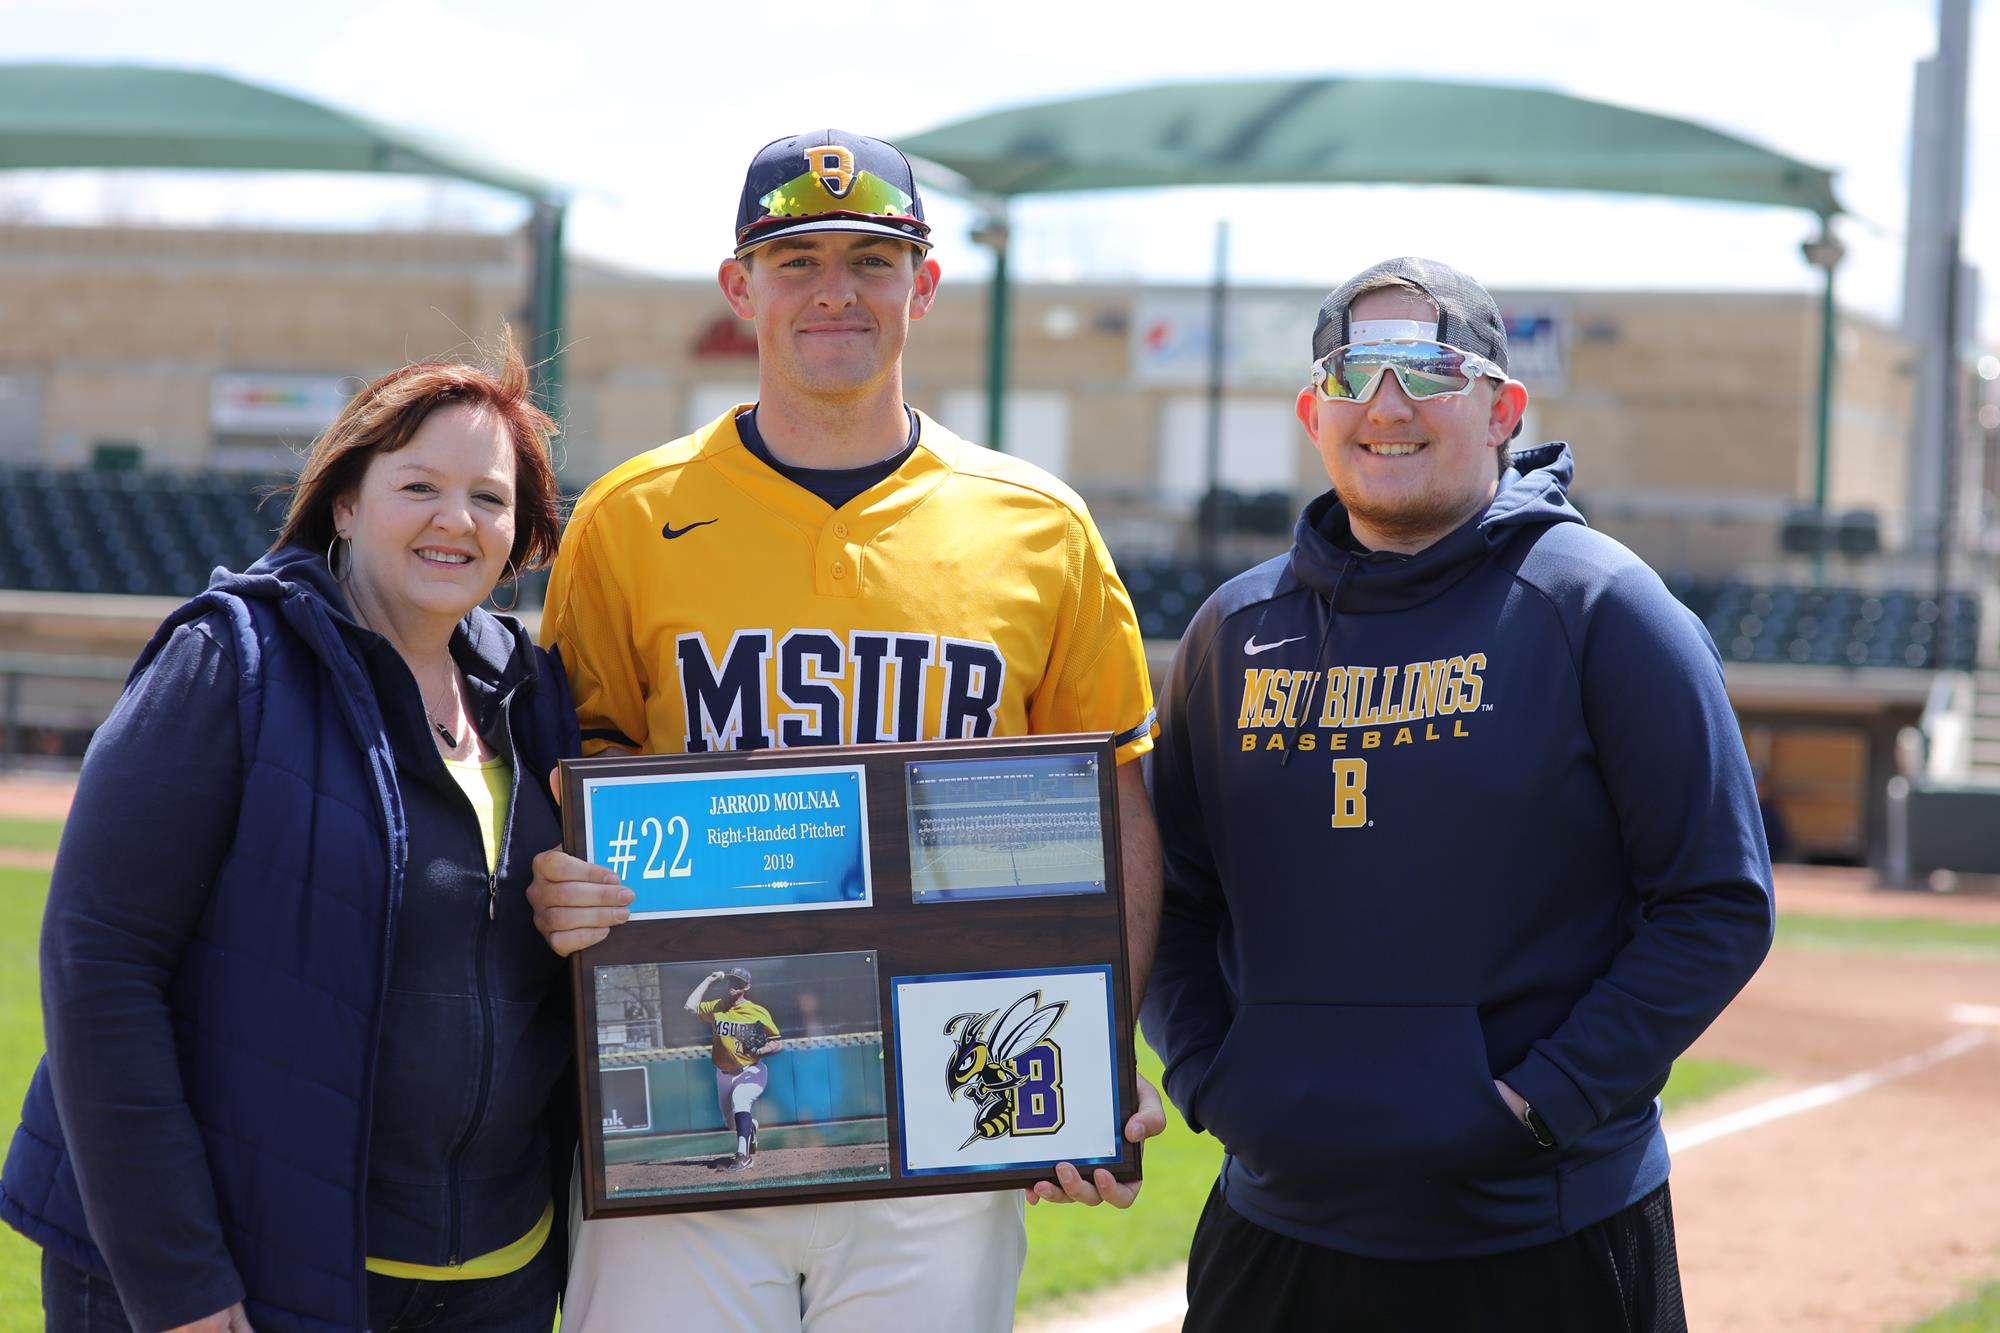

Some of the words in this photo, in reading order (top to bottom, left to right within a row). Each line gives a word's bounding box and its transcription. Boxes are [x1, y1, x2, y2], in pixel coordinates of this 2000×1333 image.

[804, 145, 855, 195] B
[675, 628, 1007, 752] MSUB
[1237, 668, 1321, 728] MSU
[1318, 653, 1487, 728] BILLINGS
[1241, 719, 1469, 752] BASEBALL
[709, 792, 770, 815] JARROD
[773, 790, 840, 812] MOLNAA
[1332, 758, 1368, 828] B
[607, 815, 692, 881] #22
[706, 823, 797, 848] Right-Handed
[799, 821, 846, 839] Pitcher
[763, 853, 794, 872] 2019
[1009, 1038, 1066, 1138] B
